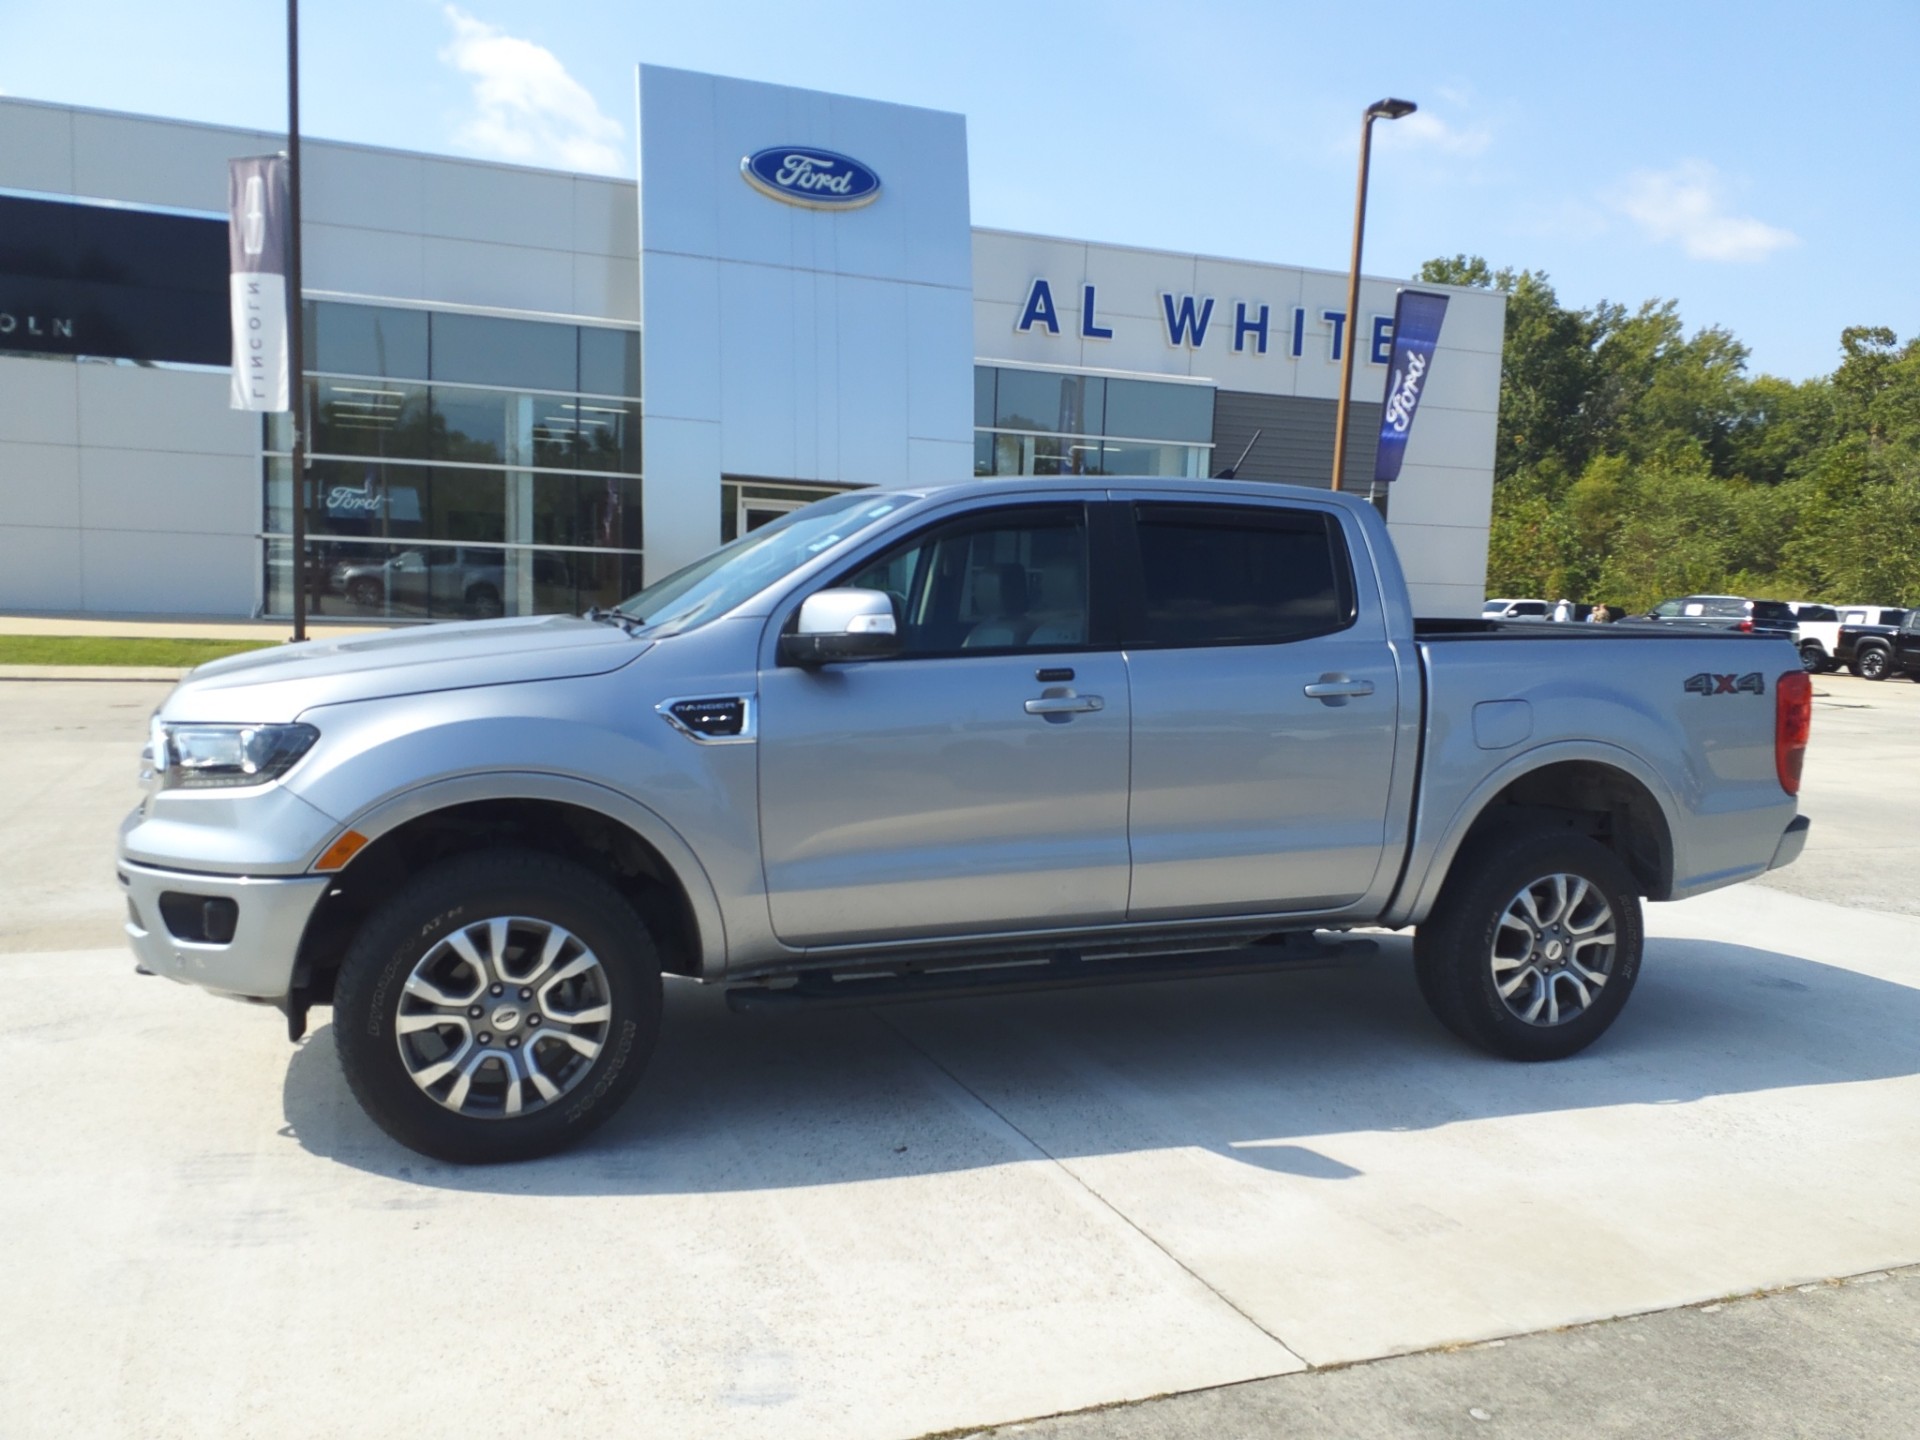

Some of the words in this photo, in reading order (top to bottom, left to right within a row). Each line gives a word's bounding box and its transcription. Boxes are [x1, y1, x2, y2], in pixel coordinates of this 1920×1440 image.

[775, 154, 853, 193] Ford
[1016, 277, 1114, 340] AL
[1160, 291, 1396, 365] WHITE
[1385, 350, 1426, 432] Ford
[326, 486, 382, 511] Ford
